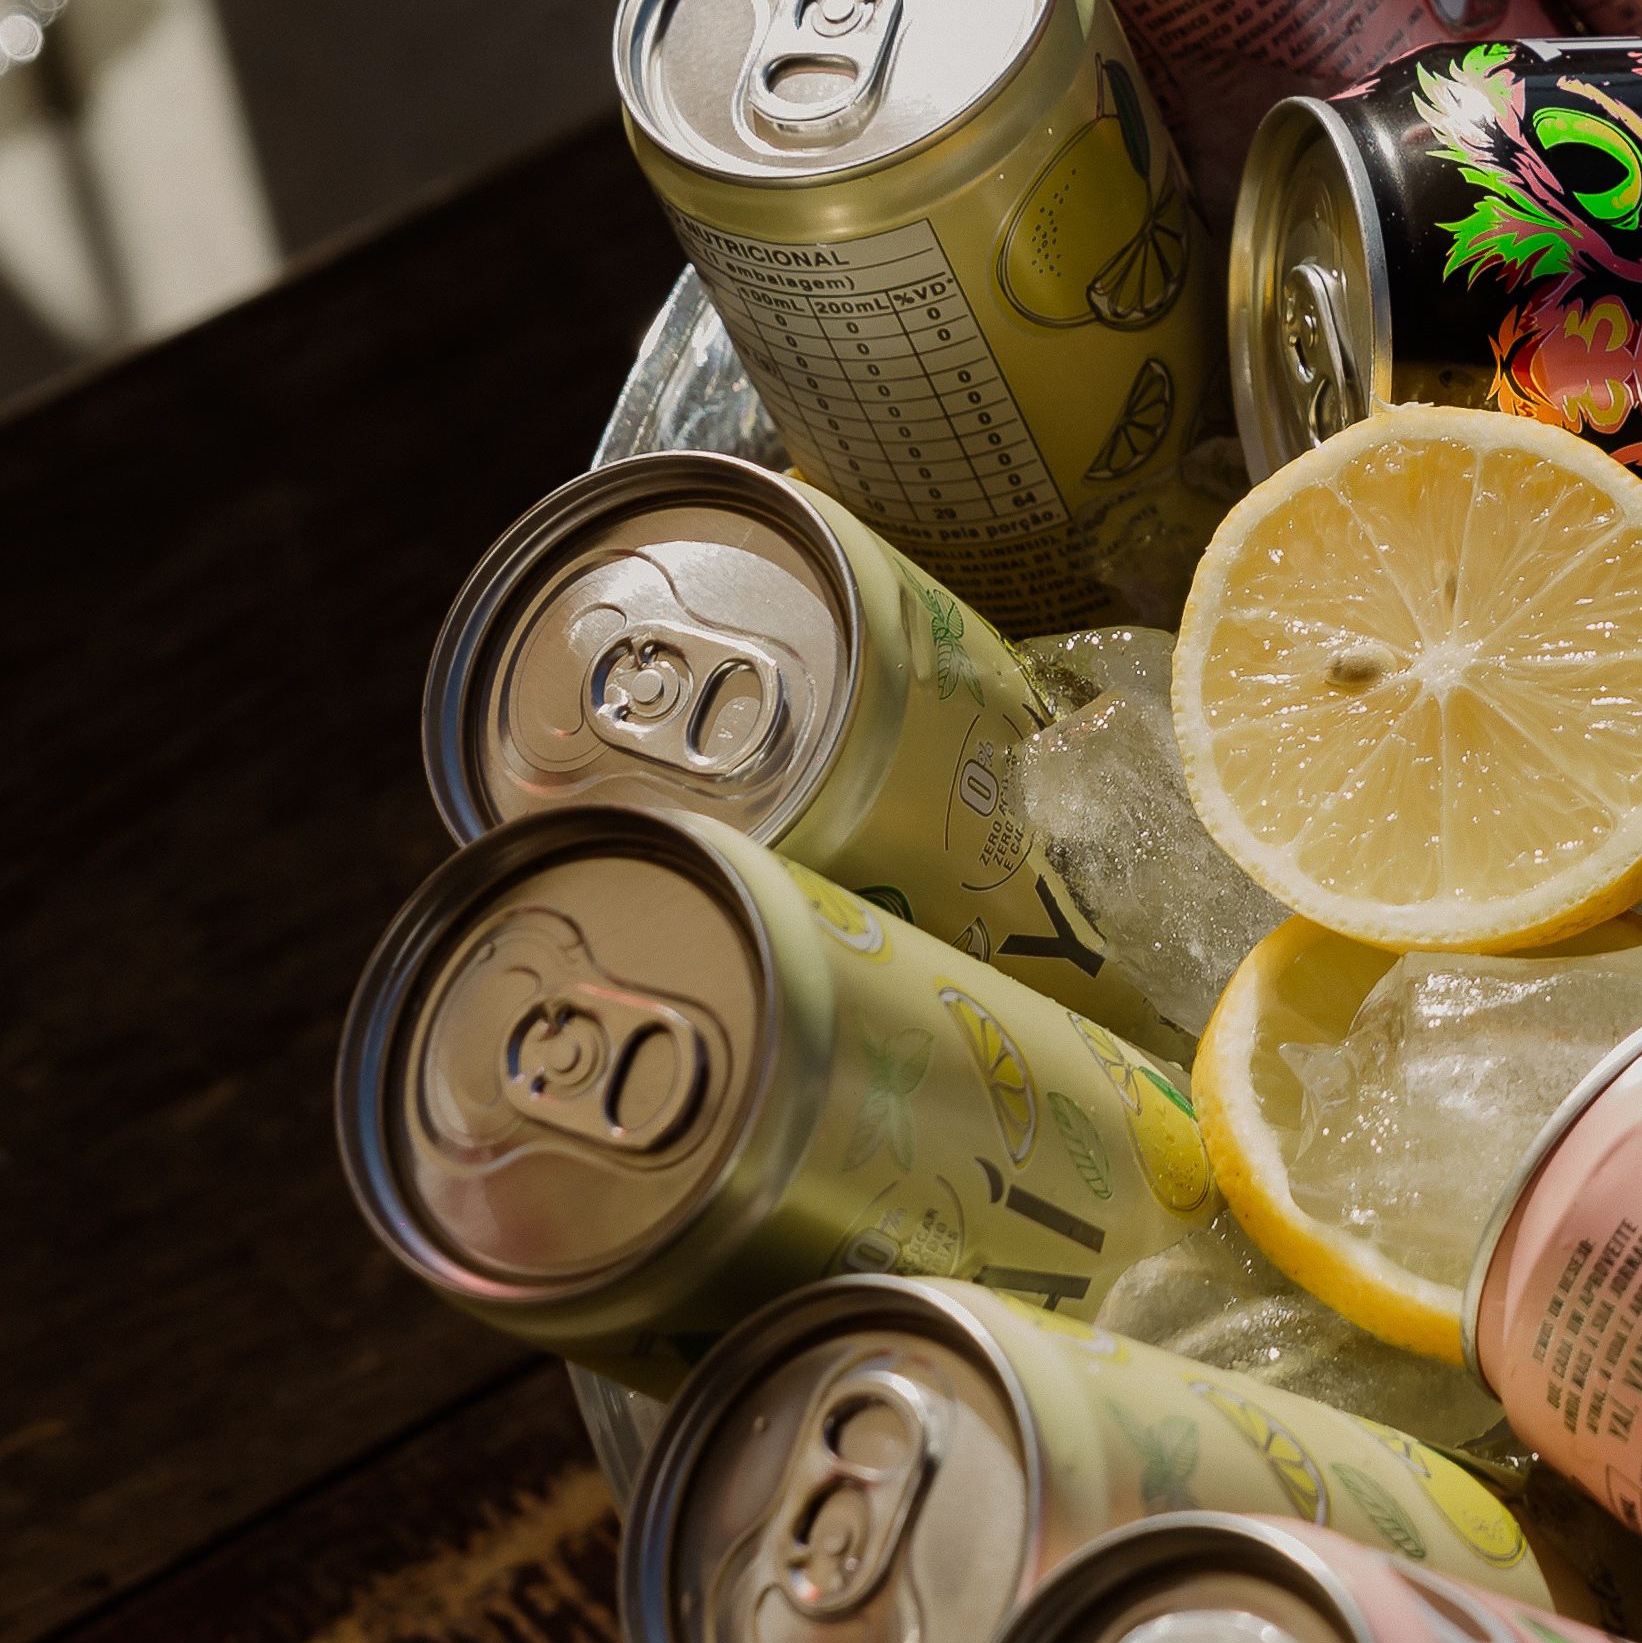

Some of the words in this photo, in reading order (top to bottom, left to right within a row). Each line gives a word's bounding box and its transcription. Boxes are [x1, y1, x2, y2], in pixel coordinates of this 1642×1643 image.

[686, 218, 850, 268] NUTRICIONAL
[726, 262, 856, 292] embalagem)
[815, 298, 890, 316] 200mL
[775, 314, 788, 327] 0
[846, 322, 859, 334] 0
[928, 308, 940, 320] 0
[786, 336, 797, 348] 0
[857, 343, 870, 356] 0
[937, 329, 950, 342] 0
[868, 364, 880, 376] 0
[878, 385, 891, 397] 0
[957, 370, 971, 383] 0
[889, 406, 900, 418] 0
[968, 391, 981, 403] 0
[899, 427, 911, 439] 0
[978, 412, 991, 425] 0
[909, 447, 921, 459] 0
[988, 432, 1001, 446] 0
[919, 468, 931, 480] 0
[998, 453, 1012, 466] 0
[929, 488, 942, 500] 0
[1008, 474, 1021, 486] 0
[940, 527, 980, 541] pela
[980, 821, 1003, 867] ZERO
[993, 821, 1015, 866] ZERO
[1579, 1218, 1636, 1306] APROVEITE
